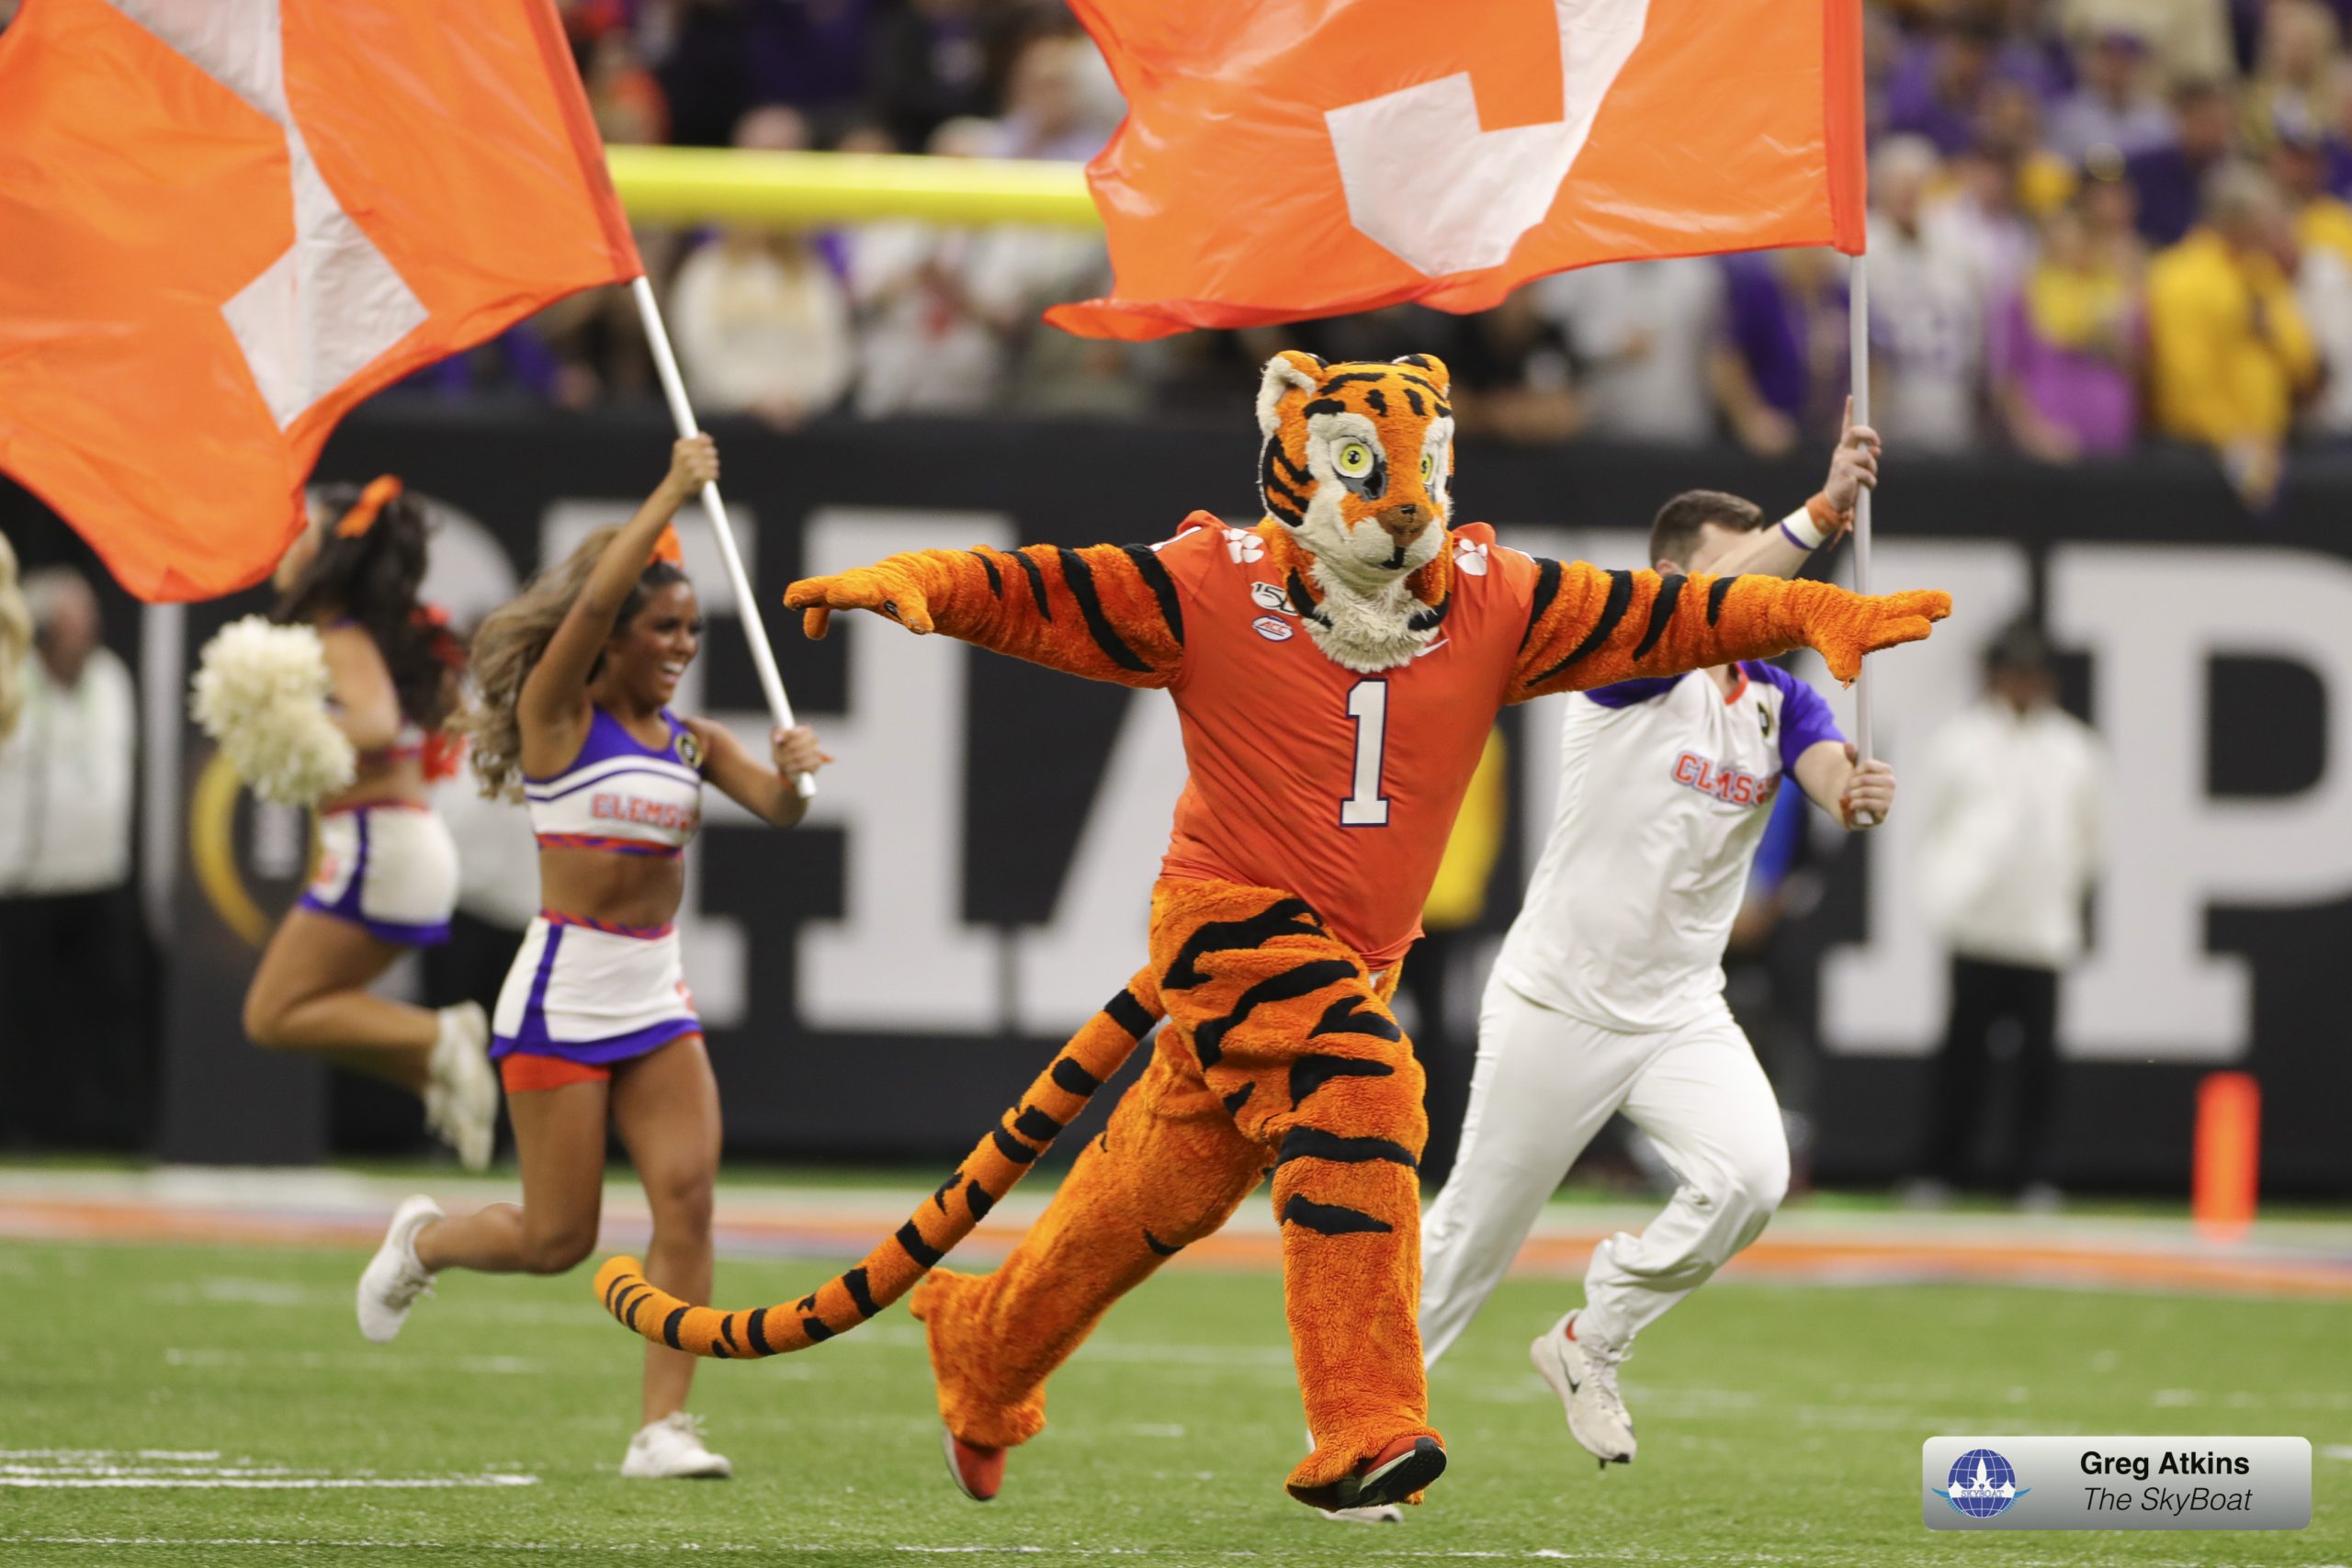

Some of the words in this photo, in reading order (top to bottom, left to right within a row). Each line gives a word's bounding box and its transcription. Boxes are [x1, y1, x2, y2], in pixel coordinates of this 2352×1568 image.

[1257, 621, 1291, 636] ACC
[1340, 678, 1389, 827] 1
[591, 793, 700, 833] CLEMS
